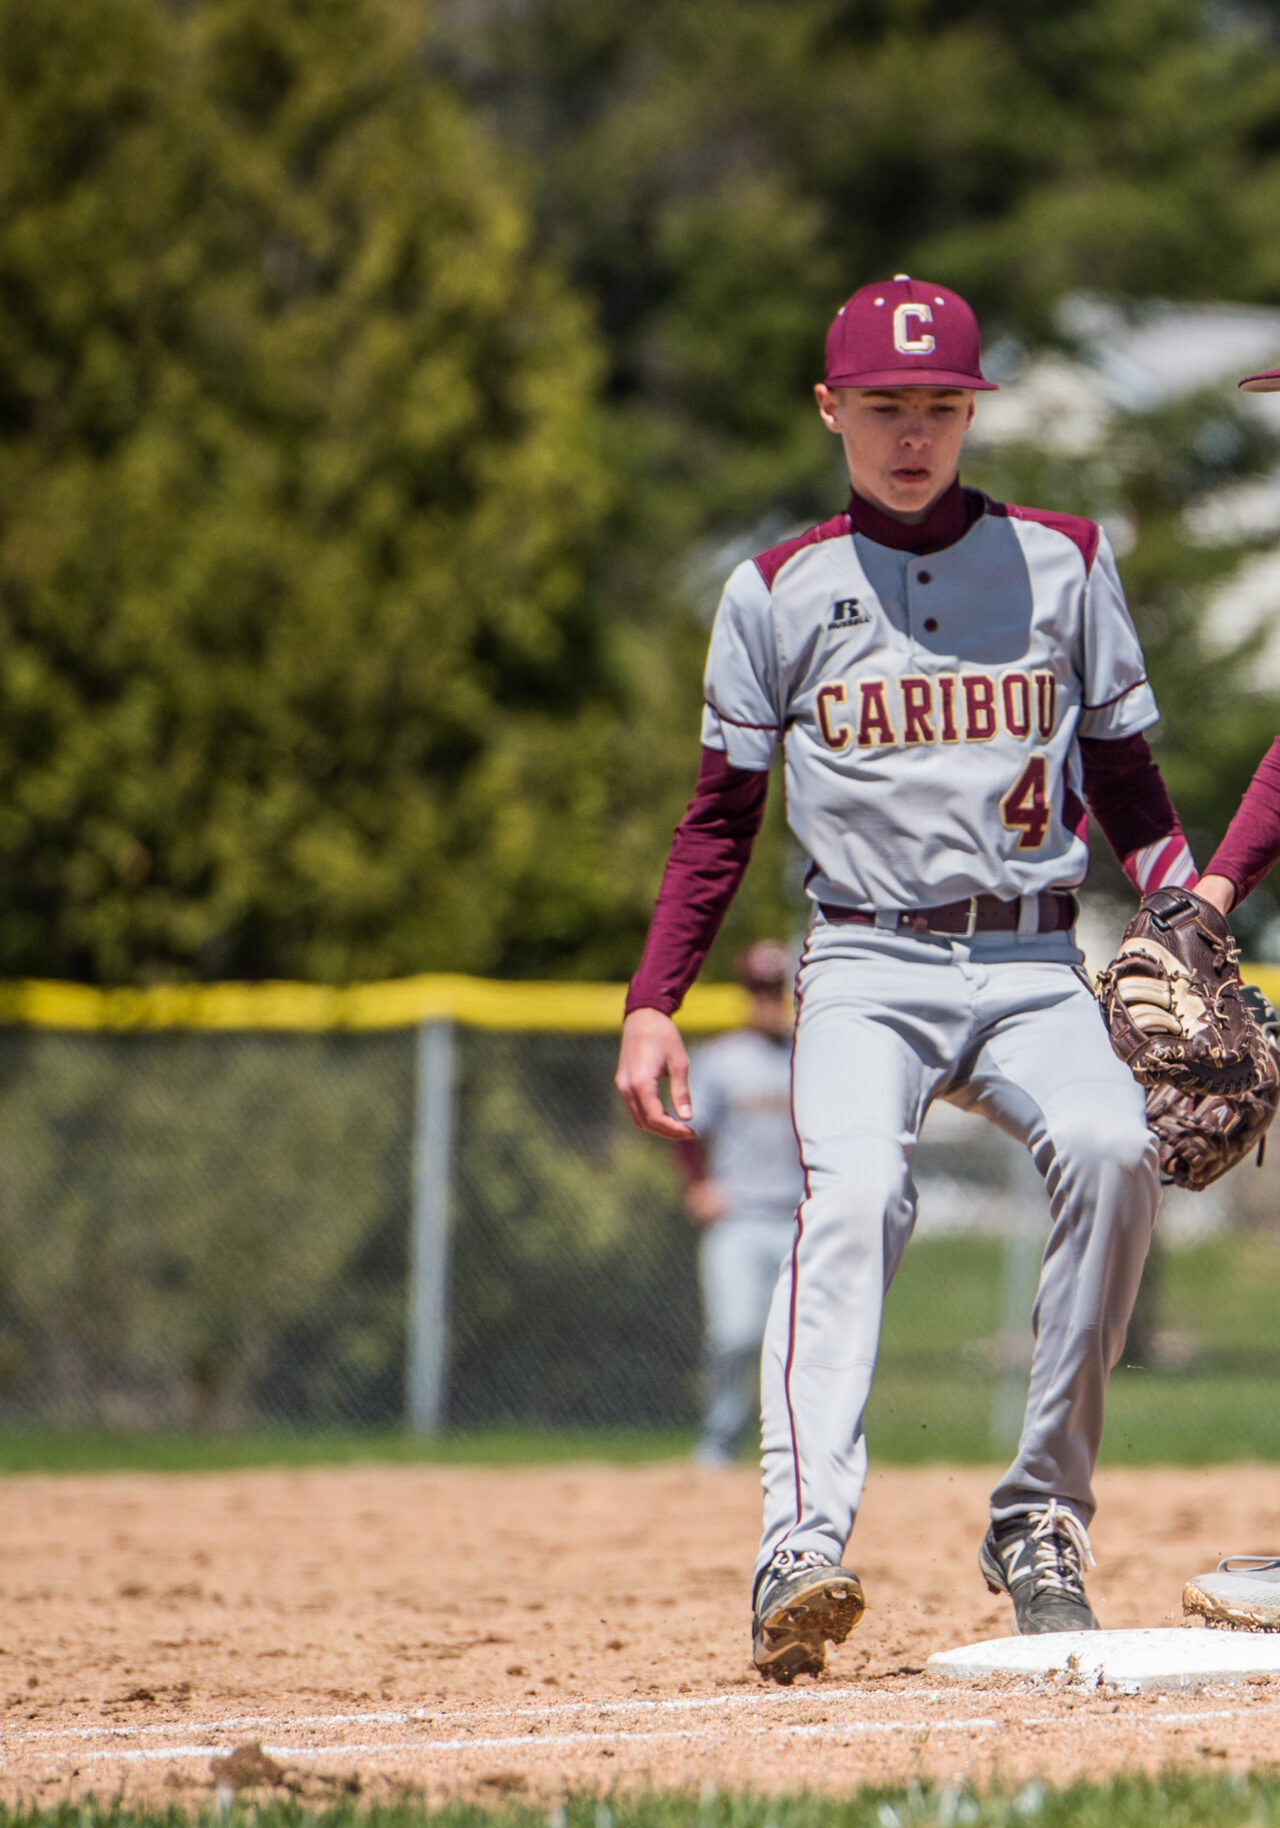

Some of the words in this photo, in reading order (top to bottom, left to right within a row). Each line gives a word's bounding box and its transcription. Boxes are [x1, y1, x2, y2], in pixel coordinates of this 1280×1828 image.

[893, 303, 936, 355] C
[815, 670, 1057, 750] CARIBOU
[1000, 752, 1050, 851] 4
